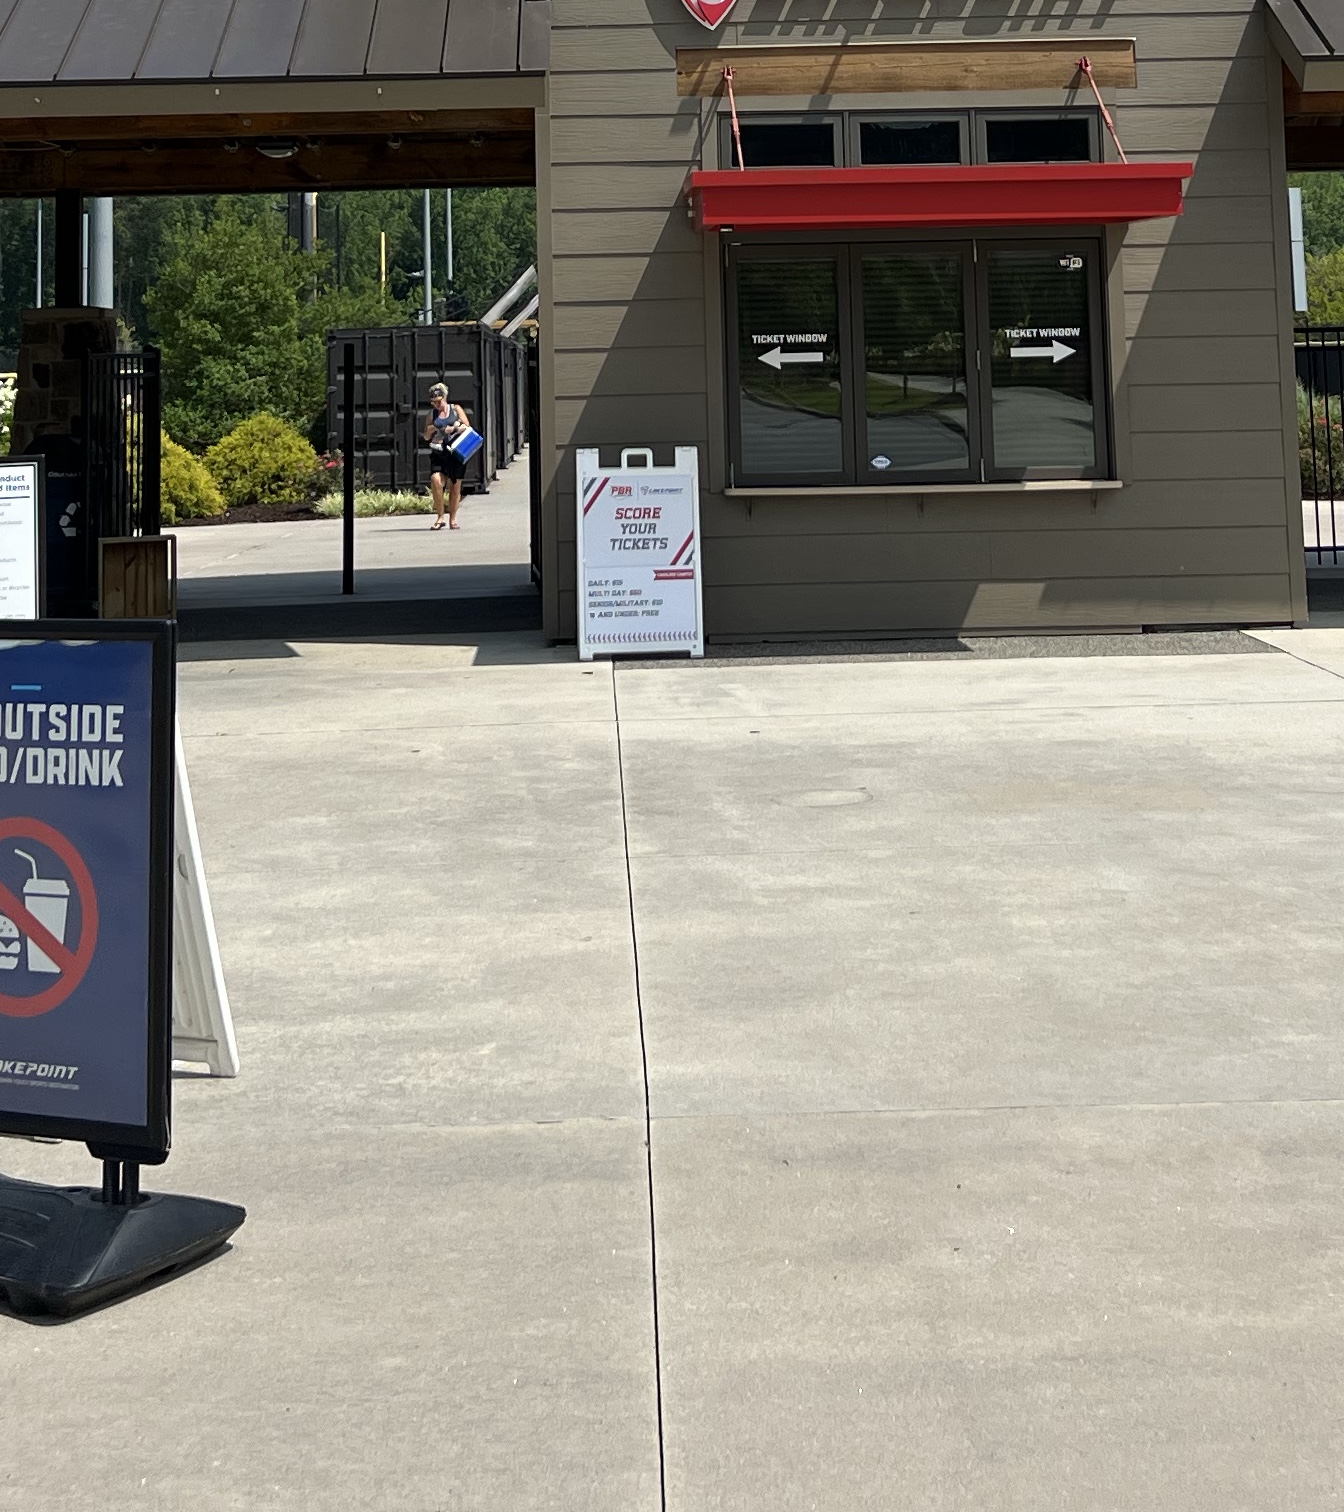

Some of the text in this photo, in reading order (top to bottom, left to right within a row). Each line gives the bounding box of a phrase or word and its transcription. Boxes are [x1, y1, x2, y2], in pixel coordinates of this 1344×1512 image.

[751, 333, 828, 344] TICKET WINDOW
[1005, 327, 1080, 338] TICKET WINDOW
[5, 484, 30, 492] Items
[615, 507, 662, 520] SCORE
[620, 522, 657, 535] YOUR
[610, 537, 669, 551] TICKETS
